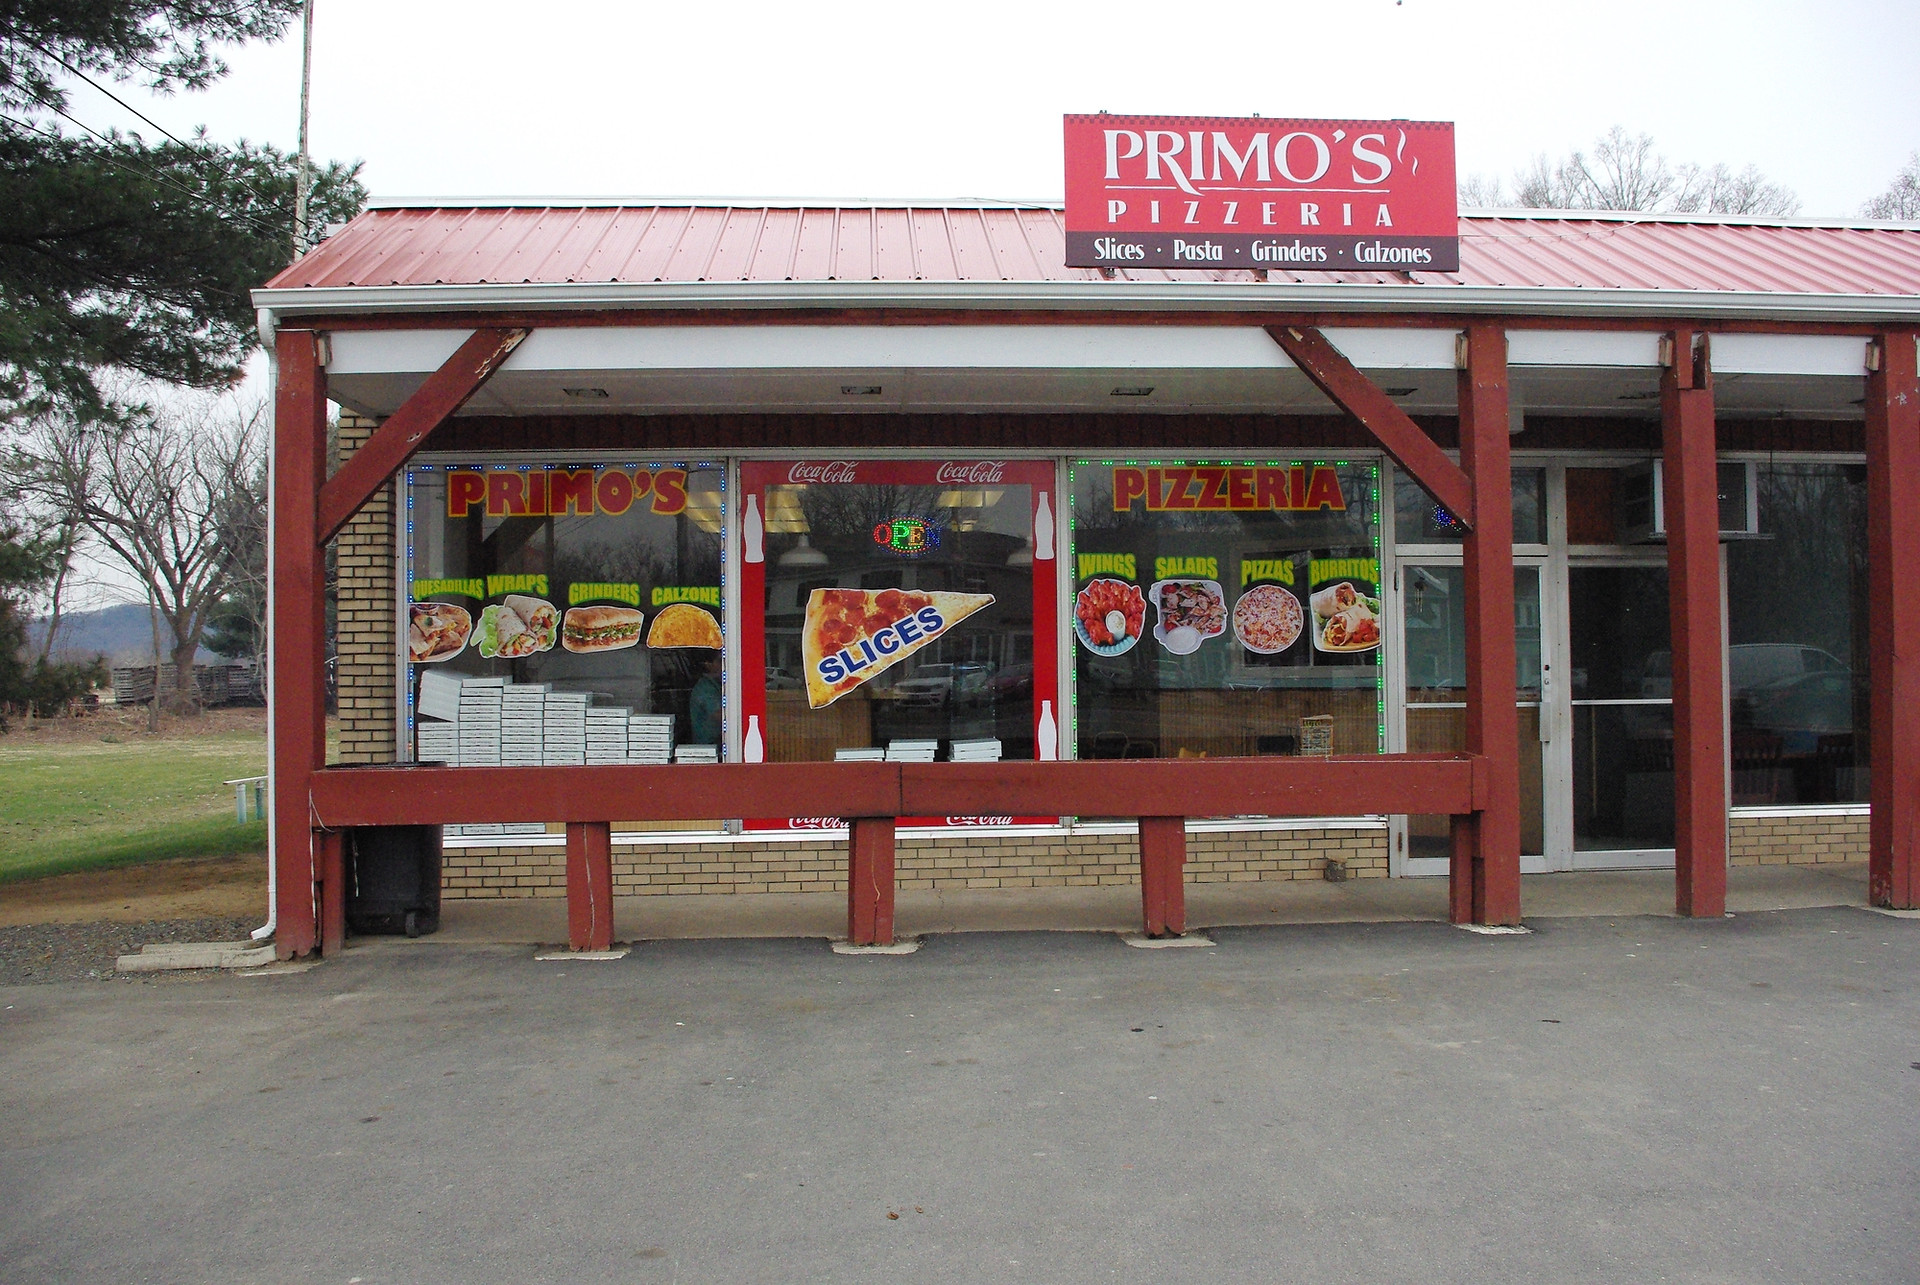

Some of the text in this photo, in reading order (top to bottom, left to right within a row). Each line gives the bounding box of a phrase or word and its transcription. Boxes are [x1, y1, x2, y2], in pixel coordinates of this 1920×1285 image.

[1104, 130, 1393, 195] PRIMO'S
[1108, 200, 1393, 227] PIZZERIA
[1094, 238, 1432, 264] Slices Pasta Grinders Calzones
[788, 461, 859, 484] Coca-Cola
[936, 461, 1007, 484] Coca-Cola
[447, 469, 687, 517] PRIMO'S
[1113, 466, 1347, 511] PIZZERIA
[873, 523, 941, 547] OPEN
[1078, 553, 1136, 580] WINGS
[1155, 556, 1219, 580] SALADS
[1241, 559, 1294, 586] PIZZAS
[1309, 558, 1380, 586] BURRITOS
[413, 578, 485, 601] QUESADILLAS
[487, 573, 549, 598] WRAPS
[568, 582, 641, 606] GRINDERS
[651, 586, 721, 607] CALZONE
[817, 605, 944, 683] SLICES
